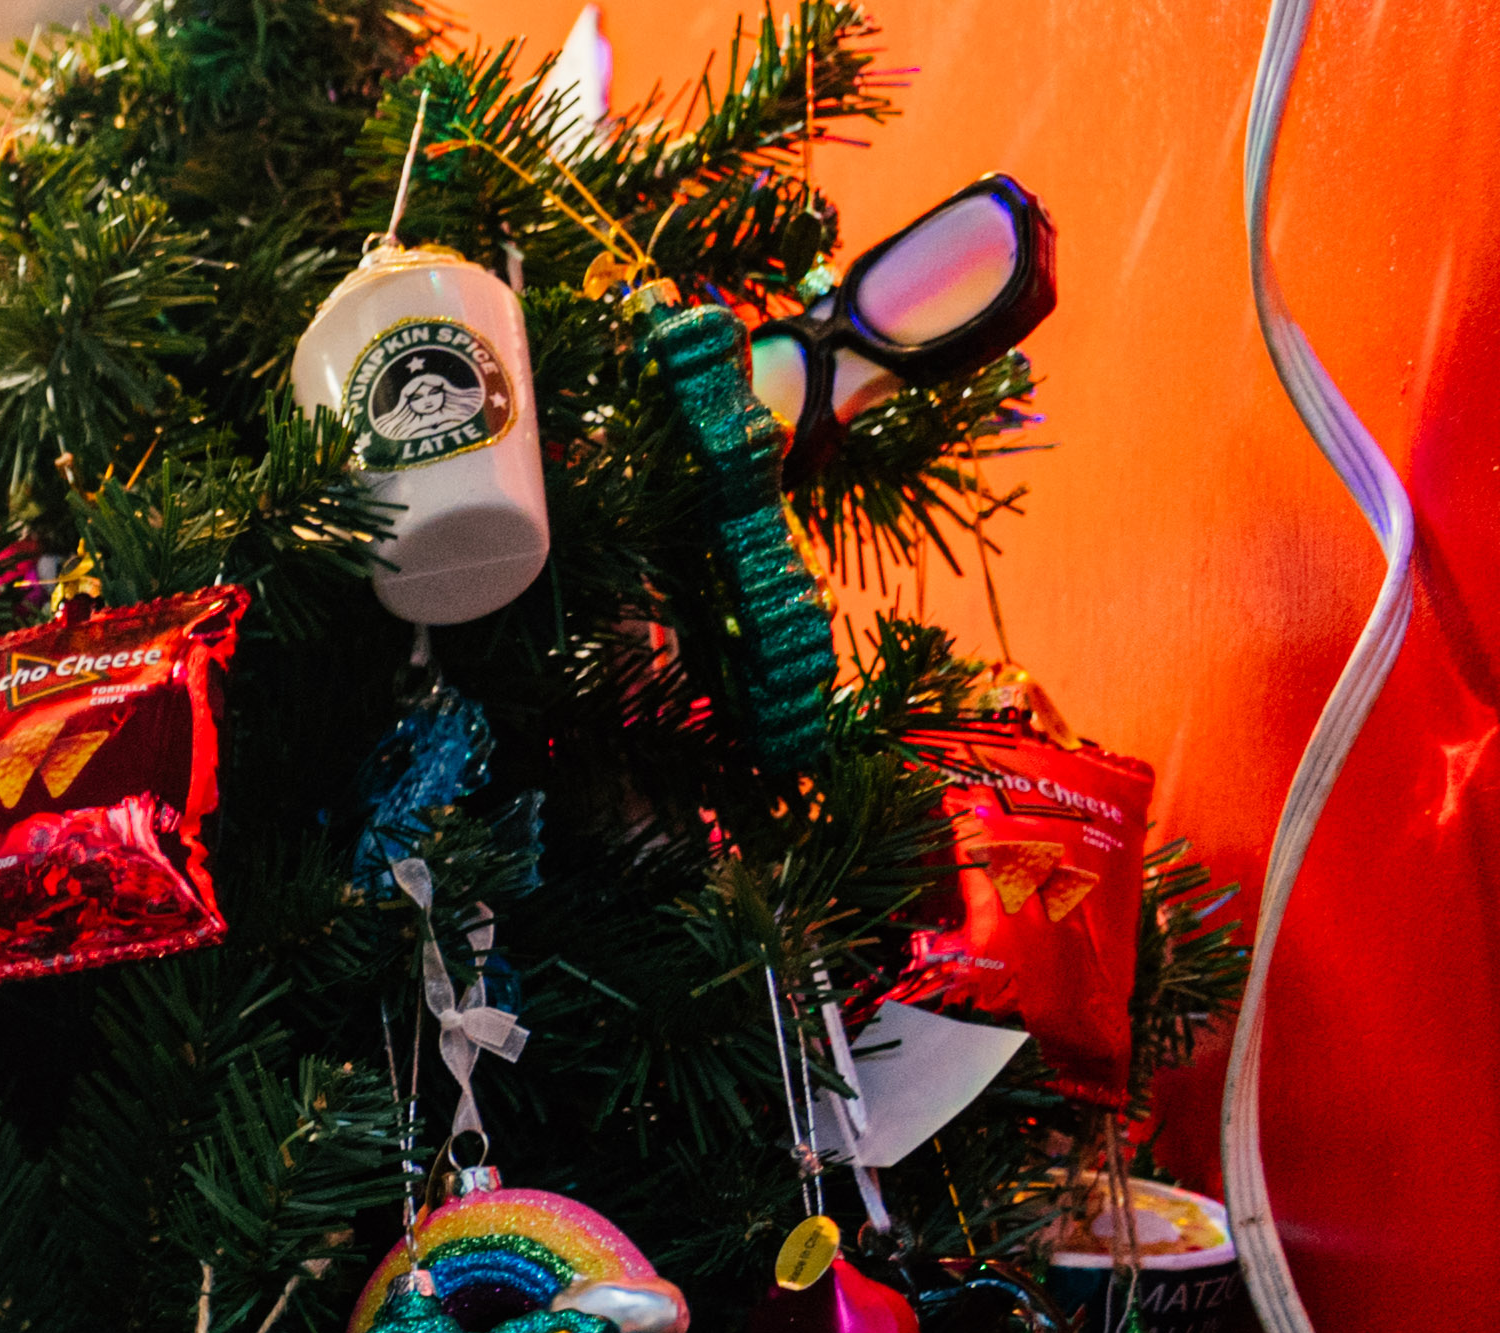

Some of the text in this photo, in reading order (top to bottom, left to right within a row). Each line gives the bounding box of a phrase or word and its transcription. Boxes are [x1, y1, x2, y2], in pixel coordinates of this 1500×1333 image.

[350, 326, 499, 417] PUMPKIN SPICE
[402, 422, 483, 460] LATTE
[55, 649, 162, 677] Cheese
[89, 694, 125, 707] CHIPS
[91, 684, 148, 697] TORTILLA
[1037, 779, 1124, 824] Cheese
